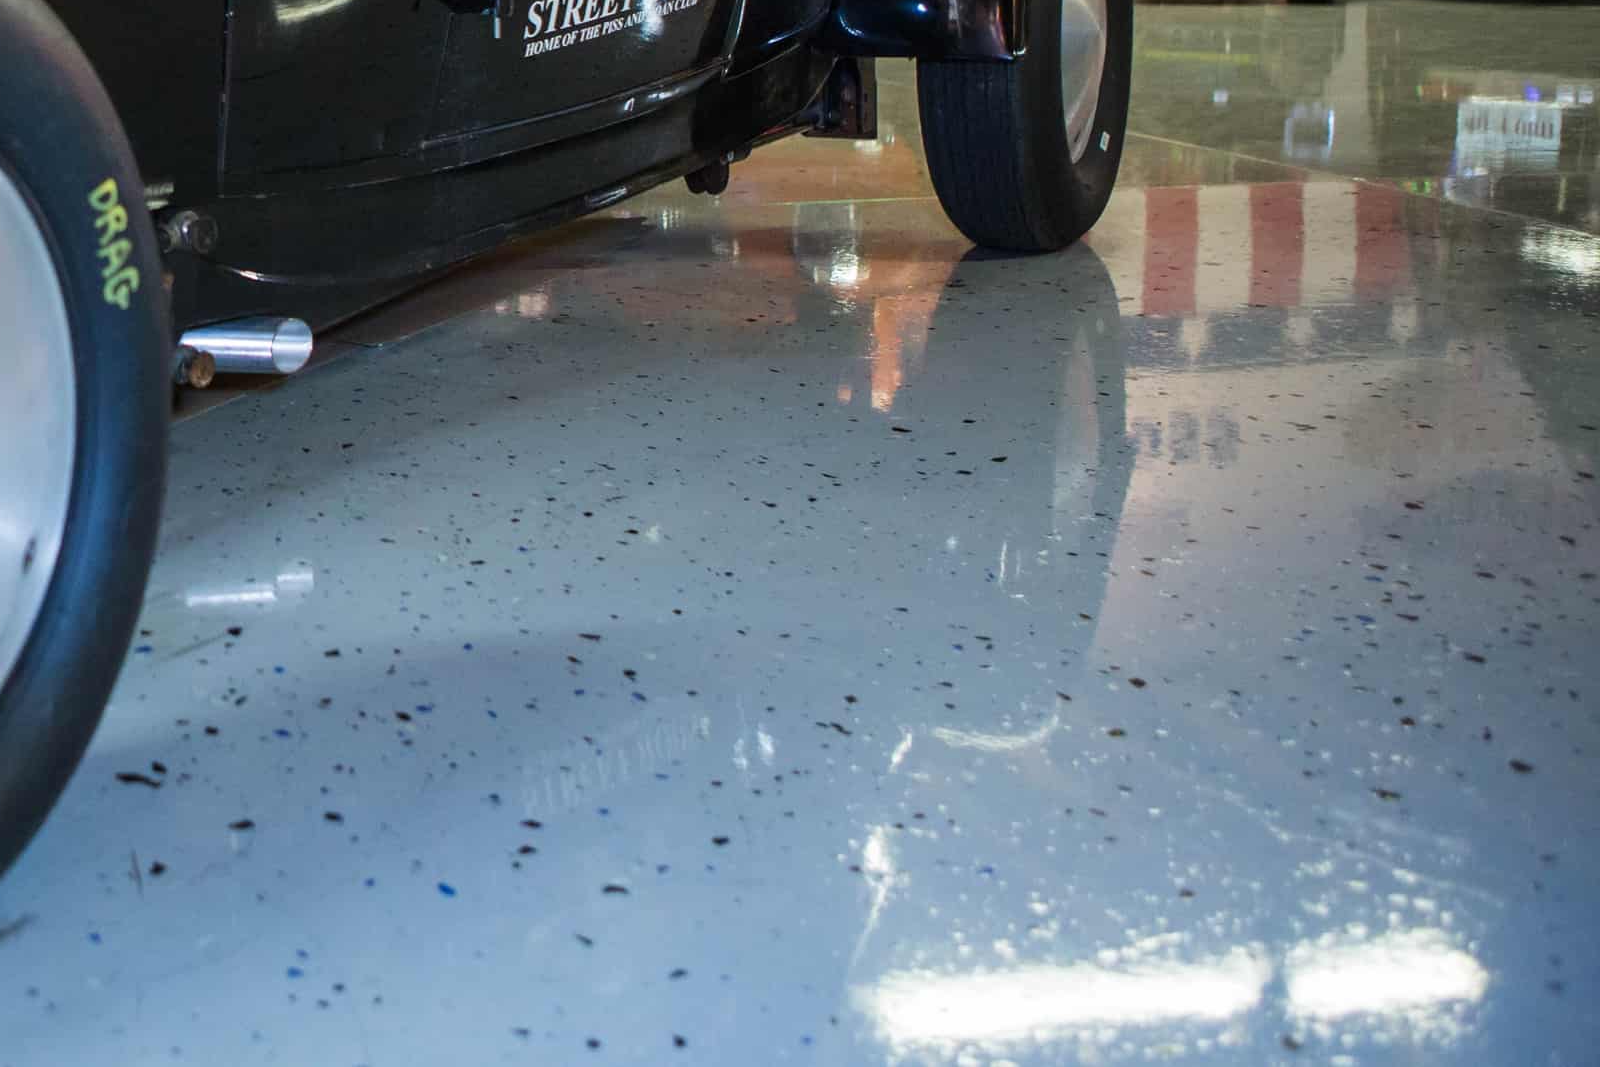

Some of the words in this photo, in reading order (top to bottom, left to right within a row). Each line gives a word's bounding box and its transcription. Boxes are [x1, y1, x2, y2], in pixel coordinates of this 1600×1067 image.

[524, 35, 561, 58] HOME
[561, 31, 580, 47] OF
[579, 25, 600, 42] THE
[602, 17, 624, 35] PISS
[88, 178, 141, 311] DRAG
